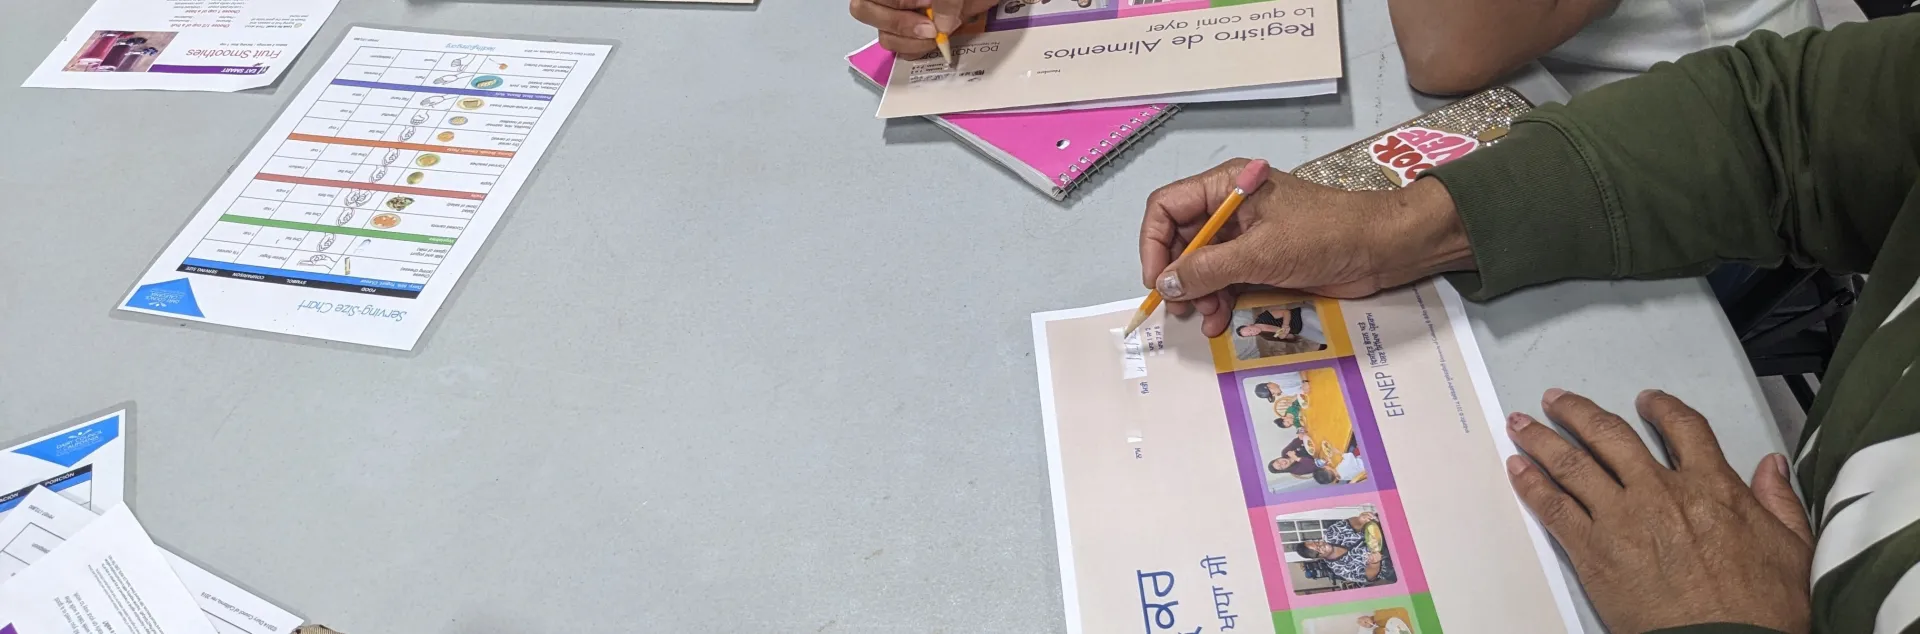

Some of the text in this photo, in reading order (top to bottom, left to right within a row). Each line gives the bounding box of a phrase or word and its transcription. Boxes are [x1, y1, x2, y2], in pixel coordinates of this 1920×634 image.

[1145, 7, 1315, 34] Lo que comí ayer
[950, 47, 976, 57] NOT
[979, 45, 999, 53] DO
[1043, 22, 1315, 61] Registro de Alimentos
[186, 49, 282, 58] Fruit Smoothies
[1373, 136, 1433, 180] OOK
[297, 299, 407, 322] Serving-Size Chart
[1375, 372, 1404, 417] EFNEP
[1200, 555, 1227, 578] ਸੀ
